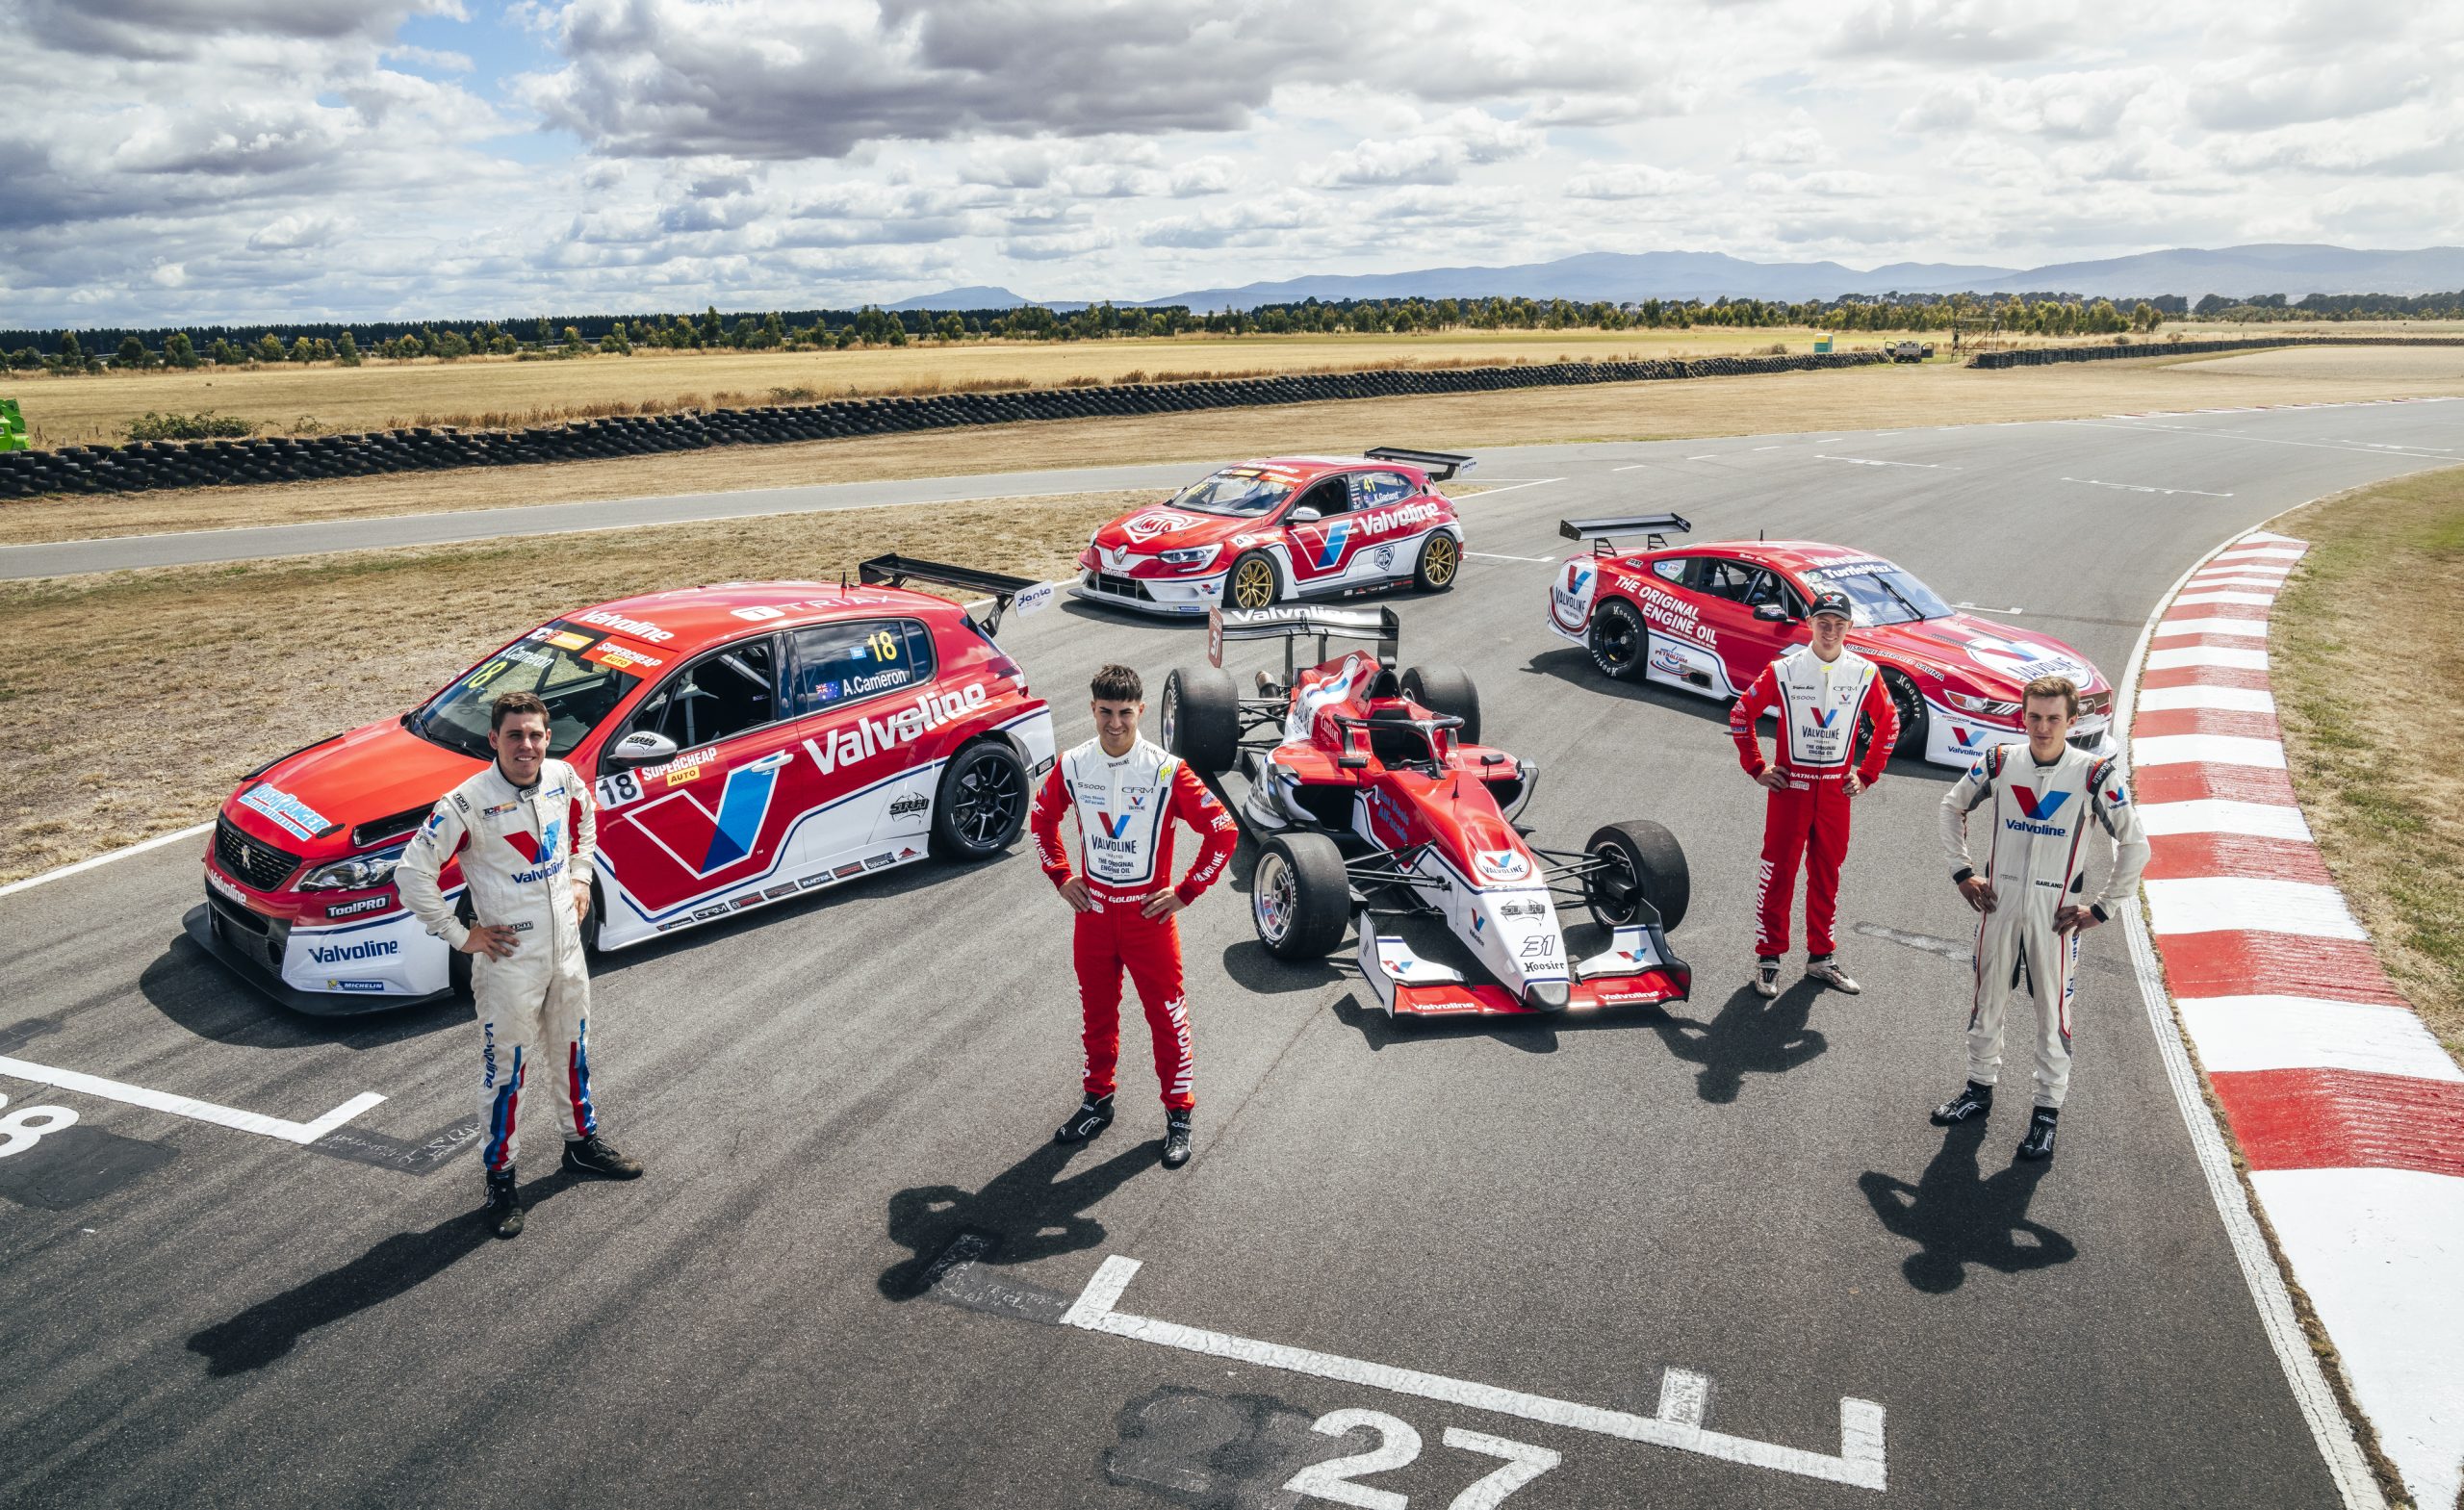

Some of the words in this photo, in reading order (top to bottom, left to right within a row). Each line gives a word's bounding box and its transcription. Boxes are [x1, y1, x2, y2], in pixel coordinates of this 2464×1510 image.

[1362, 477, 1376, 494] 41
[1357, 502, 1442, 536] Valvoline
[776, 595, 890, 613] TRIAX
[1555, 586, 1587, 618] VALVOLINE
[1614, 575, 1640, 594] THE
[1639, 585, 1700, 622] ORIGINAL
[1230, 605, 1360, 624] Valvoline
[1641, 602, 1696, 635] ENGINE
[1696, 626, 1718, 645] OIL
[578, 610, 676, 644] Valvoline
[596, 641, 663, 668] SUPERCHEAP
[866, 630, 898, 662] 18
[606, 655, 628, 666] AUTO
[462, 658, 508, 689] 18
[1916, 662, 1945, 682] SAUNA
[843, 670, 907, 698] A.Cameron
[1896, 674, 1921, 719] Hoosier
[802, 682, 988, 776] Valvoline
[1802, 725, 1840, 740] VALVOLINE
[1947, 745, 1984, 756] Valvoline
[641, 747, 718, 781] SUPERCHEAP
[670, 769, 697, 783] AUTO
[1077, 781, 1106, 791] S5000
[598, 773, 639, 806] 18
[888, 796, 930, 816] SRH
[2005, 818, 2066, 837] Valvoline
[1031, 832, 1055, 867] VALVOLIN
[1091, 834, 1137, 855] VALVOLINE
[1100, 864, 1119, 874] ENGINE
[1108, 857, 1135, 868] ORIGINAL
[1482, 863, 1524, 876] VALVOLINE
[210, 868, 248, 908] Valvoline
[2035, 880, 2064, 889] GARLAND
[327, 897, 386, 917] ToolPRO
[308, 939, 398, 963] Valvoline
[1520, 934, 1555, 958] 31
[1525, 960, 1565, 973] Hoosier
[1598, 990, 1662, 1001] Valvoline
[1411, 1001, 1476, 1011] Valvoline
[1281, 1408, 1562, 1510] 27
